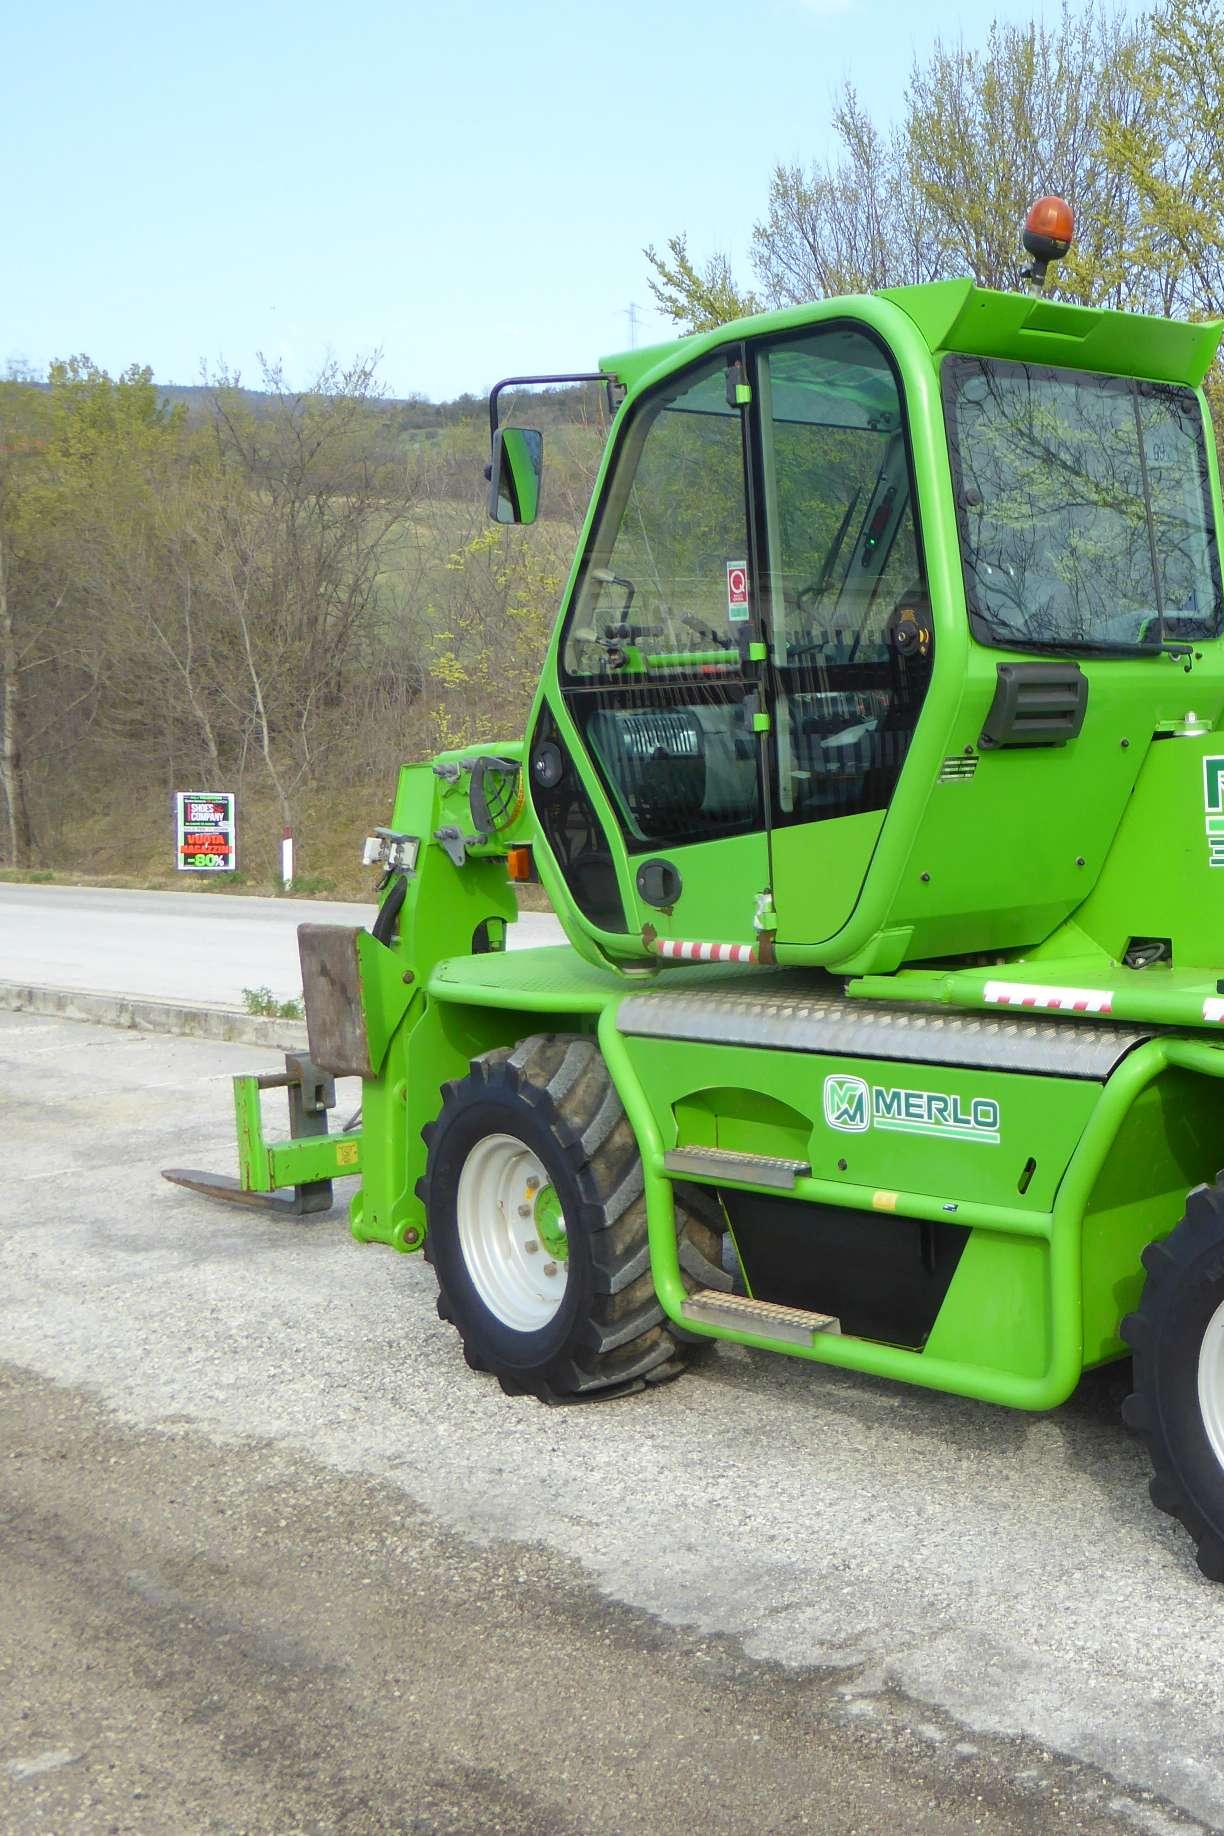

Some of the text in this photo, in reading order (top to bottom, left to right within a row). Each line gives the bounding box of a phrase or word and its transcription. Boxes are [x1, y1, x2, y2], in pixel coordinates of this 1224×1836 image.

[191, 803, 215, 813] SHOES
[191, 812, 224, 821] COMPANY
[872, 1086, 1000, 1131] MERLO
